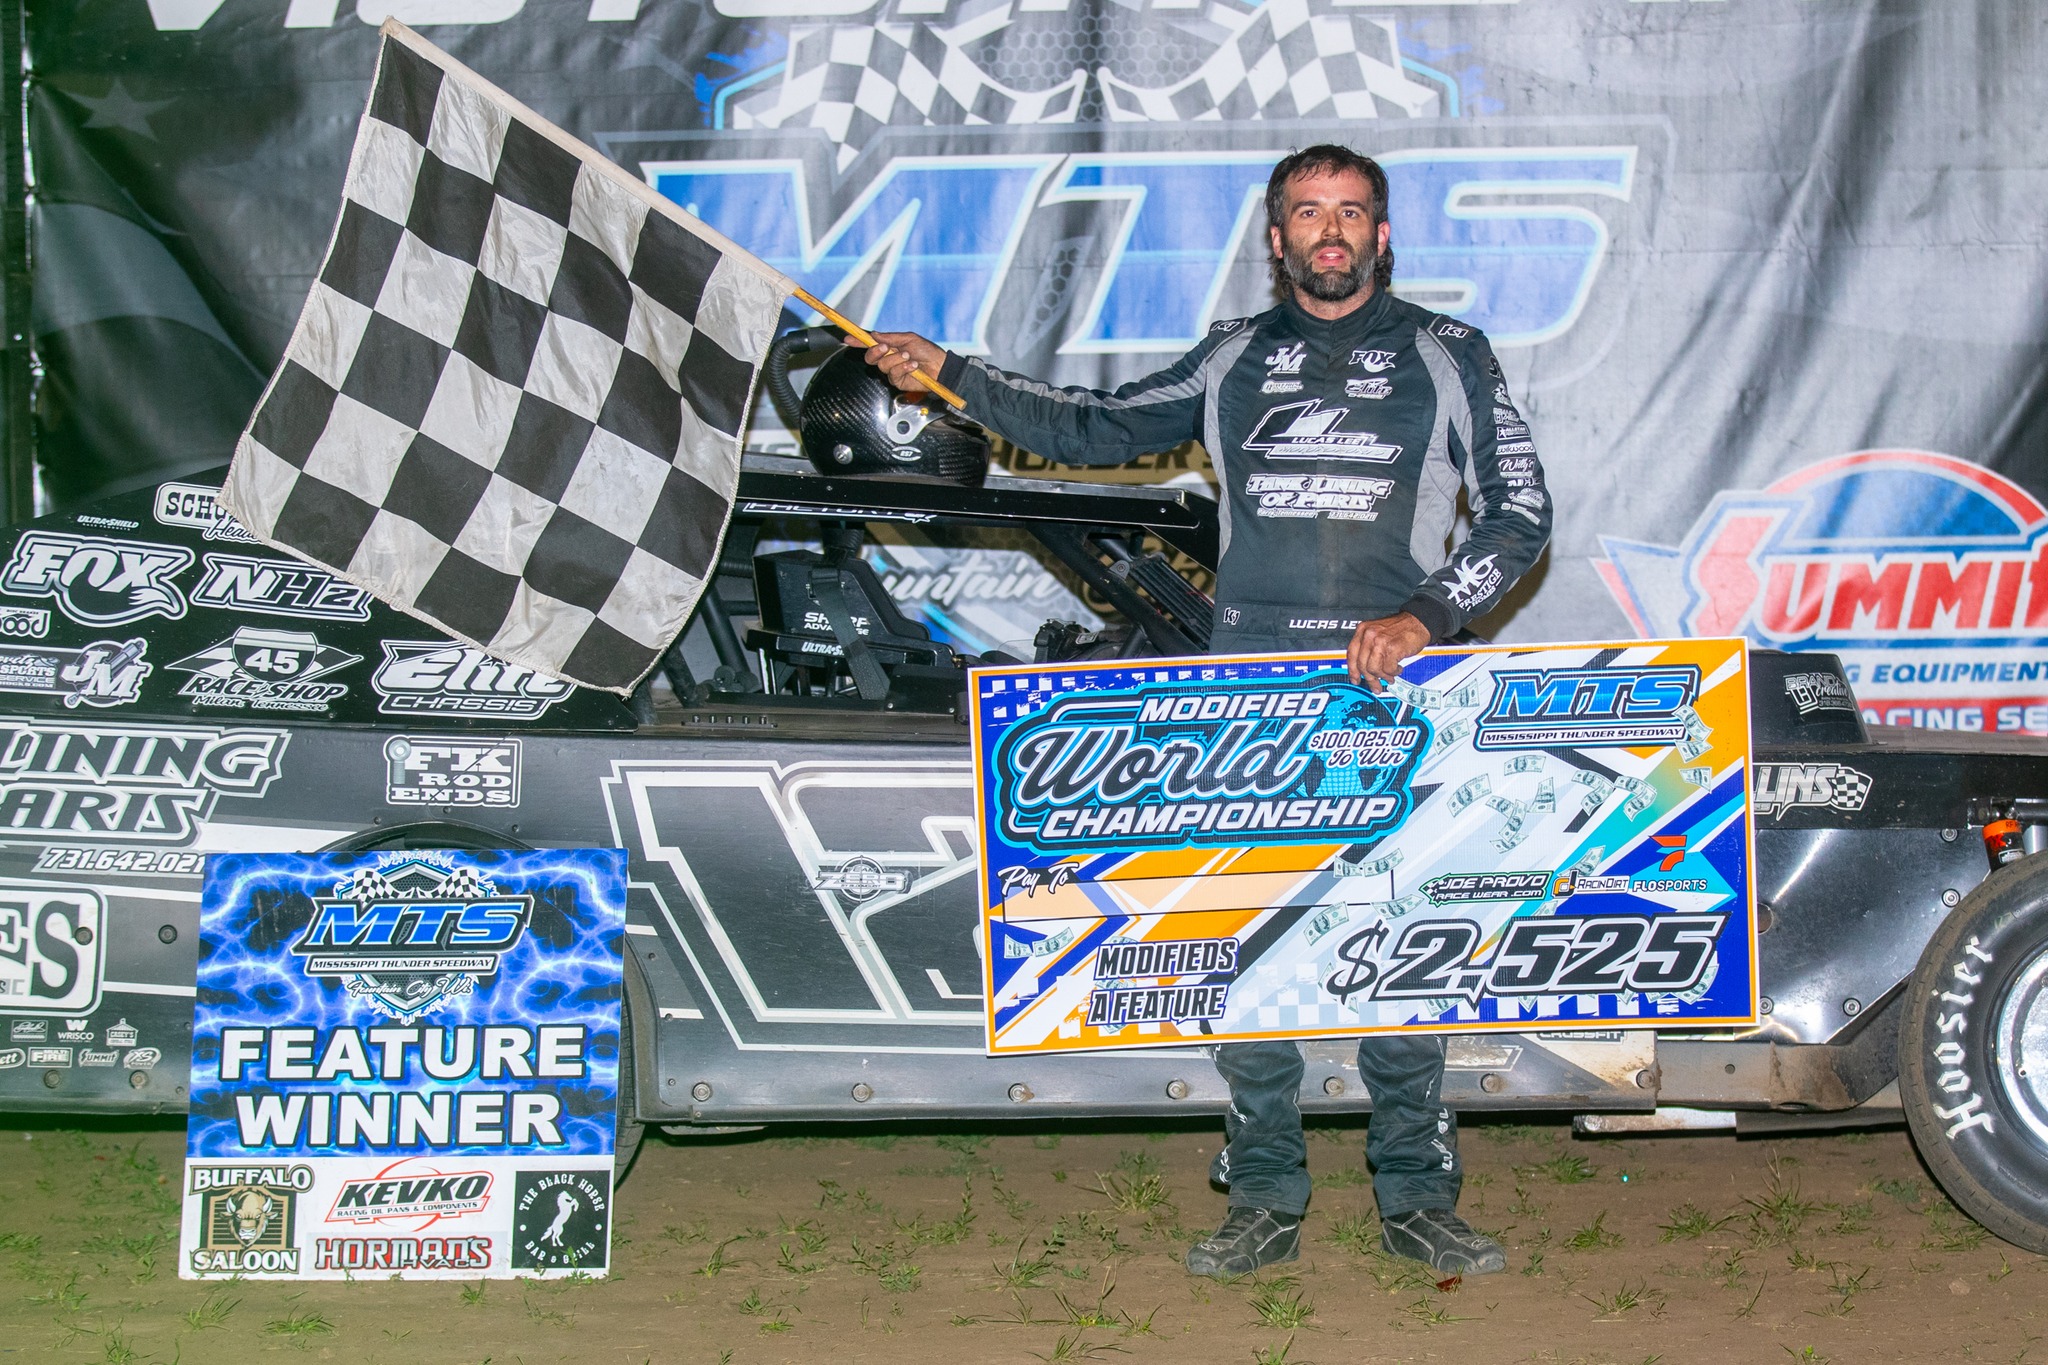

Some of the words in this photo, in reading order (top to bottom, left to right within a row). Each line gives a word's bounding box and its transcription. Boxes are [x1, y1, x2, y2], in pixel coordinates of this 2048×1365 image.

[644, 144, 1639, 358] MTS
[1349, 349, 1396, 371] FOX
[1291, 436, 1334, 444] LUCAS
[1336, 437, 1361, 445] LEE
[14, 543, 178, 594] FOX
[1459, 568, 1502, 609] PRESTIGE
[1289, 619, 1337, 629] LUCAS
[244, 648, 300, 675] 45
[186, 677, 260, 697] RACE
[262, 683, 345, 702] SHOP
[1491, 673, 1690, 718] MTS
[390, 696, 538, 712] CHASSIS
[1139, 691, 1331, 724] MODIFIED
[1484, 731, 1557, 742] MISSISSIPPI
[1560, 730, 1615, 740] THUNDER
[1616, 727, 1682, 739] SPEEDWAY
[404, 746, 512, 773] FK
[1015, 716, 1314, 807] World
[1328, 748, 1353, 766] To
[1358, 748, 1405, 766] Win
[418, 773, 512, 788] ROD
[1754, 766, 1837, 806] LINS
[391, 787, 512, 803] ENDS
[0, 788, 206, 834] ARIS
[1042, 795, 1399, 841] CHAMPIONSHIP
[43, 849, 204, 873] 731.642.021
[997, 863, 1041, 898] Pay
[1043, 862, 1080, 895] To
[1438, 876, 1476, 890] JOE
[1479, 874, 1547, 888] PROVO
[1632, 879, 1707, 893] FLOSPORTS
[1434, 891, 1470, 900] RACE
[1472, 890, 1509, 899] WEAR
[1510, 889, 1544, 898] .COM
[304, 902, 526, 947] MTS
[313, 960, 379, 969] MISSISSIPPI
[380, 960, 432, 968] THUNDER
[432, 959, 493, 968] SPEEDWAY
[1098, 940, 1237, 979] MODIFIEDS
[1326, 912, 1733, 1008] $2,525
[346, 980, 402, 997] Fountain
[406, 979, 436, 998] City
[1091, 992, 1112, 1024] A
[1112, 986, 1229, 1023] FEATURE
[57, 1031, 95, 1041] WRISCO
[1930, 935, 1995, 1140] Hoosier
[221, 1026, 585, 1080] FEATURE
[236, 1093, 563, 1147] WINNER
[193, 1167, 313, 1190] BUFFALO
[337, 1175, 490, 1208] KEVKO
[518, 1187, 539, 1211] THE
[537, 1173, 575, 1191] BLACK
[577, 1178, 606, 1212] HORSE
[337, 1208, 367, 1217] RACING
[371, 1207, 383, 1215] OIL
[387, 1206, 410, 1214] PANS
[423, 1201, 478, 1211] COMPONENTS
[193, 1250, 299, 1271] SALOON
[401, 1257, 471, 1268] HVAC
[524, 1240, 547, 1261] BAR
